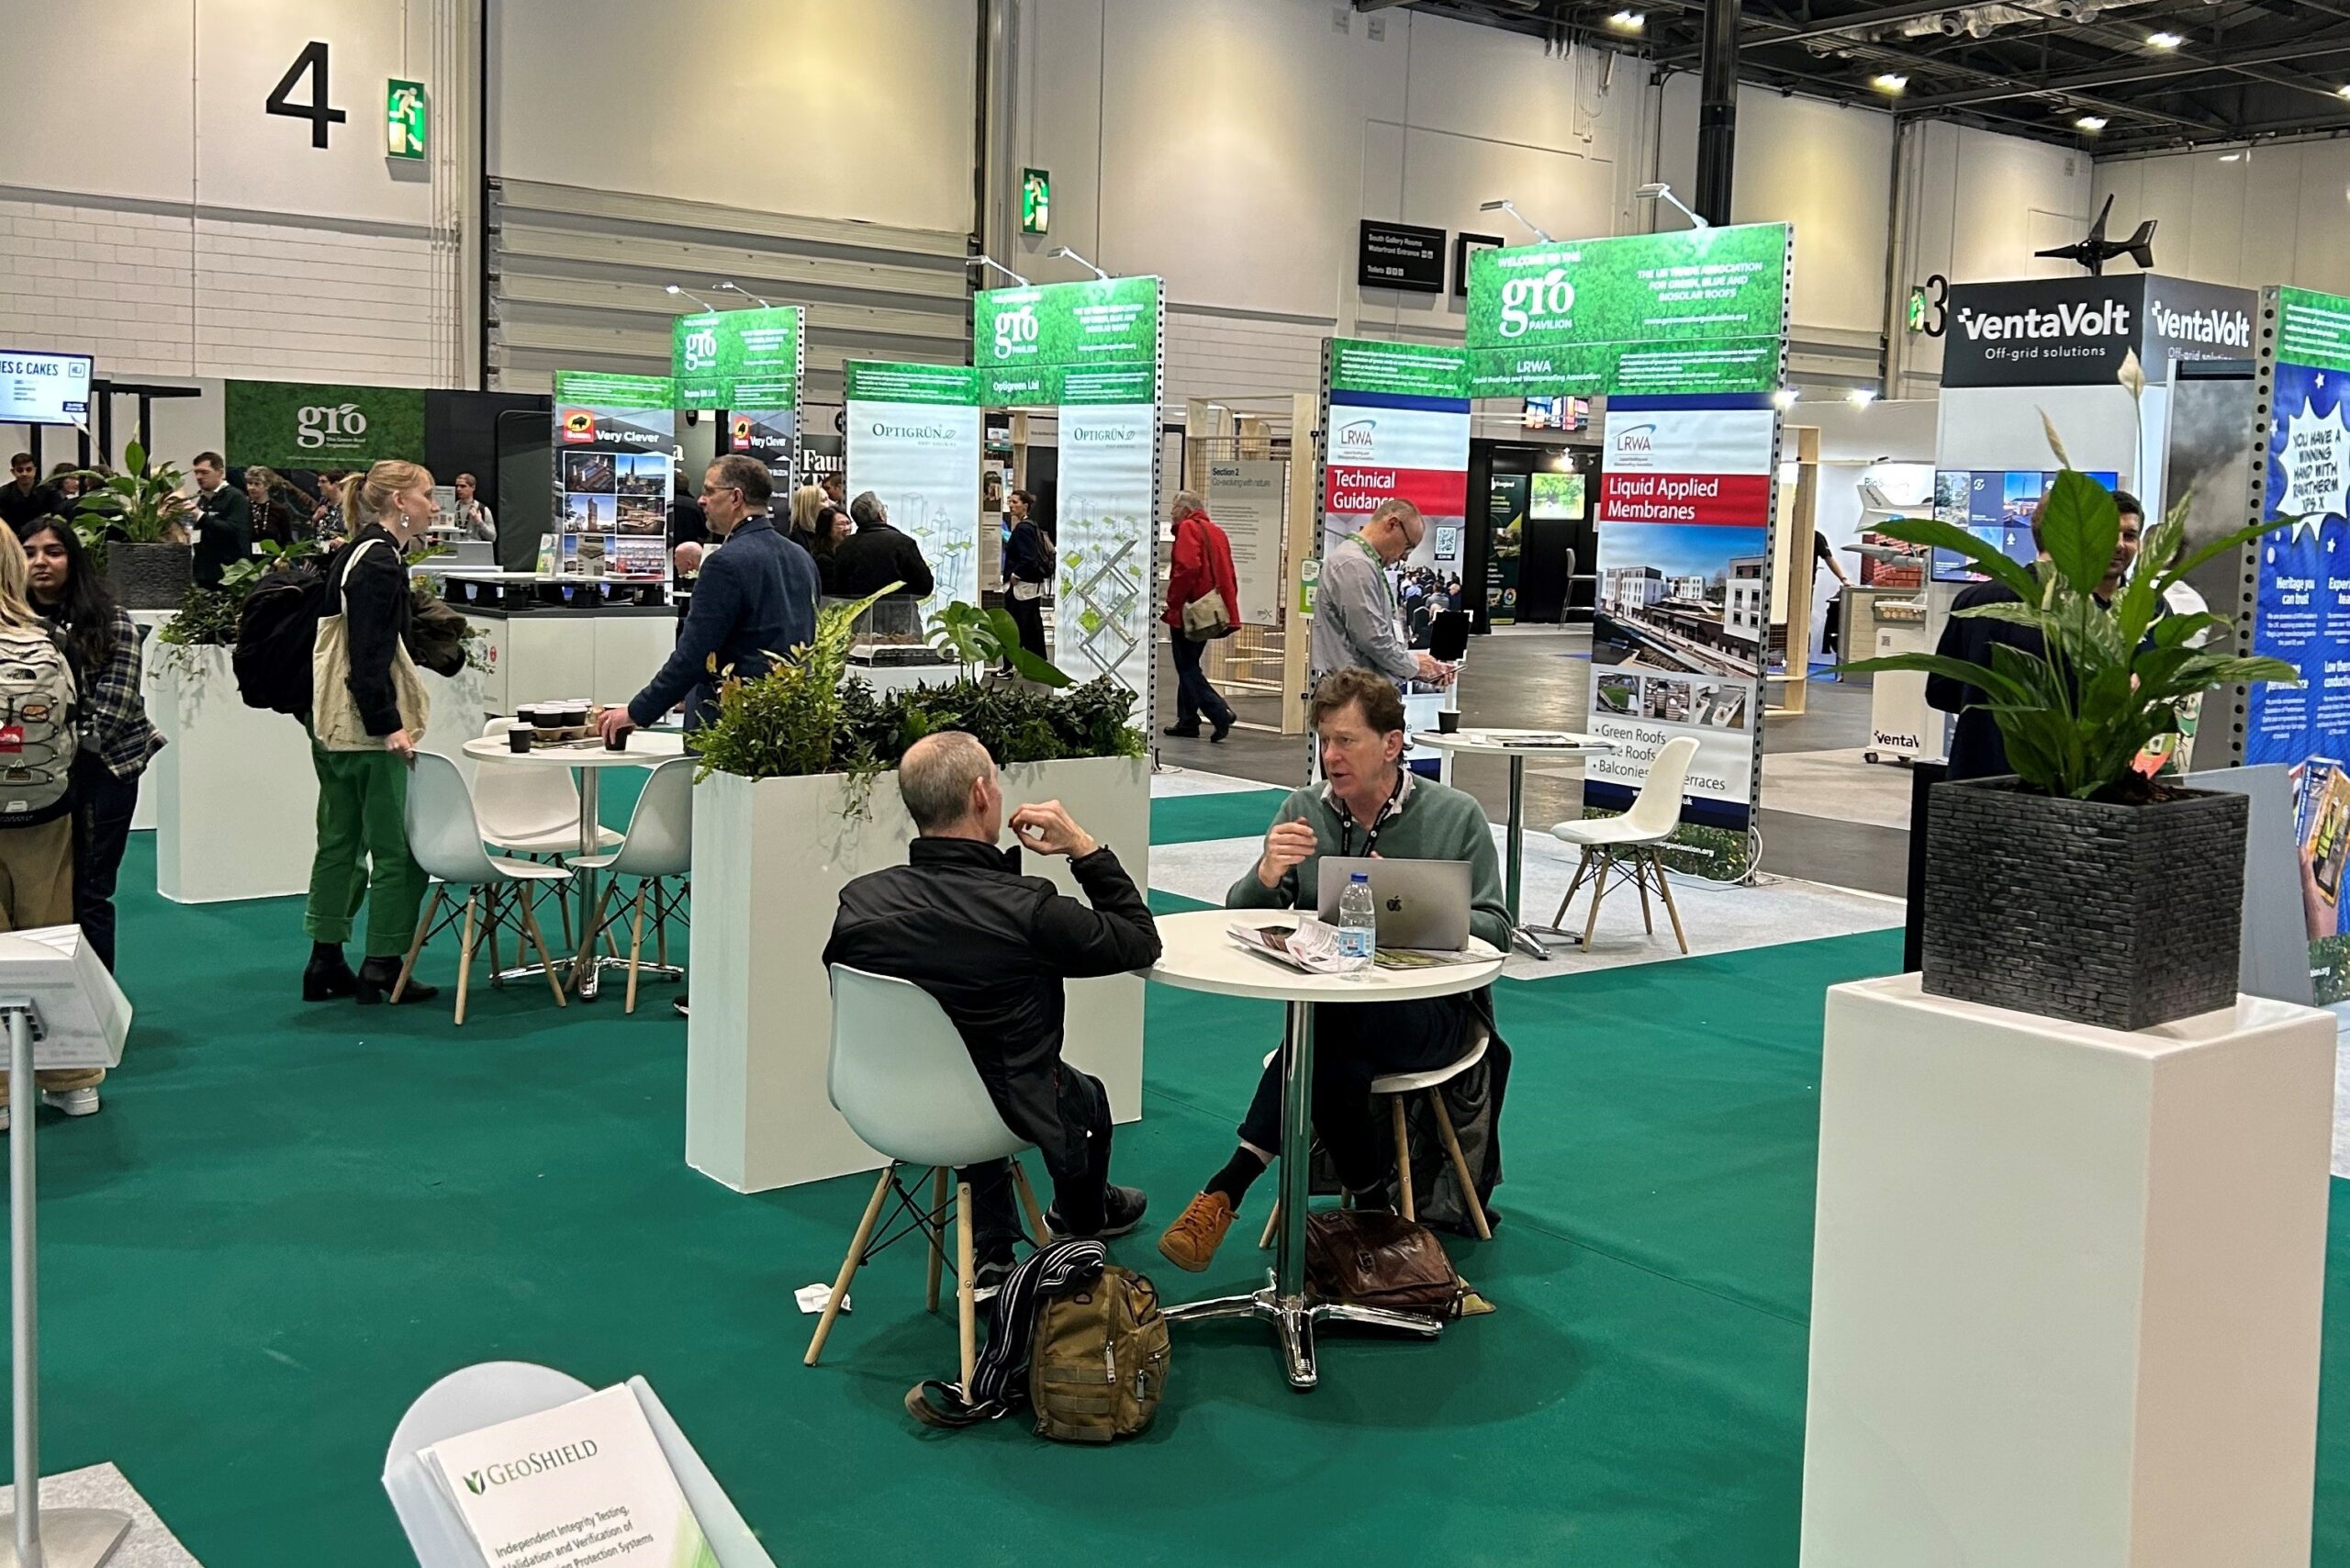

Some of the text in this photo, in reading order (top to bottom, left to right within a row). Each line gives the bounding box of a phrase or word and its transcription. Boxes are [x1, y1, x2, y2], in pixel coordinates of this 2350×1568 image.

[266, 41, 346, 149] 4
[1924, 274, 1948, 337] 3
[1528, 319, 1572, 330] PAVILION
[1985, 346, 2106, 361] Off-grid solutions
[0, 361, 14, 374] ES
[27, 363, 59, 375] CAKES
[1516, 360, 1551, 373] LRWA
[297, 403, 366, 449] gro
[596, 431, 660, 442] Very Clever
[1340, 430, 1372, 445] LRWA
[1617, 436, 1651, 451] LRWA
[2334, 428, 2342, 444] A
[802, 449, 843, 472] Fau
[1212, 467, 1235, 476] Section
[1334, 469, 1395, 488] Technical
[1609, 476, 1718, 500] Liquid Applied
[1333, 491, 1394, 510] Guidan
[1607, 499, 1695, 521] Membranes
[1601, 724, 1666, 745] Green Roofs
[1626, 745, 1656, 762] Roofs
[1599, 759, 1650, 778] Balconies
[1684, 775, 1726, 790] erraces
[495, 1506, 630, 1558] Independent Integrity Testing,
[554, 1542, 574, 1557] and
[572, 1526, 622, 1549] Verification
[622, 1519, 633, 1531] of
[573, 1533, 654, 1568] Protection Systems
